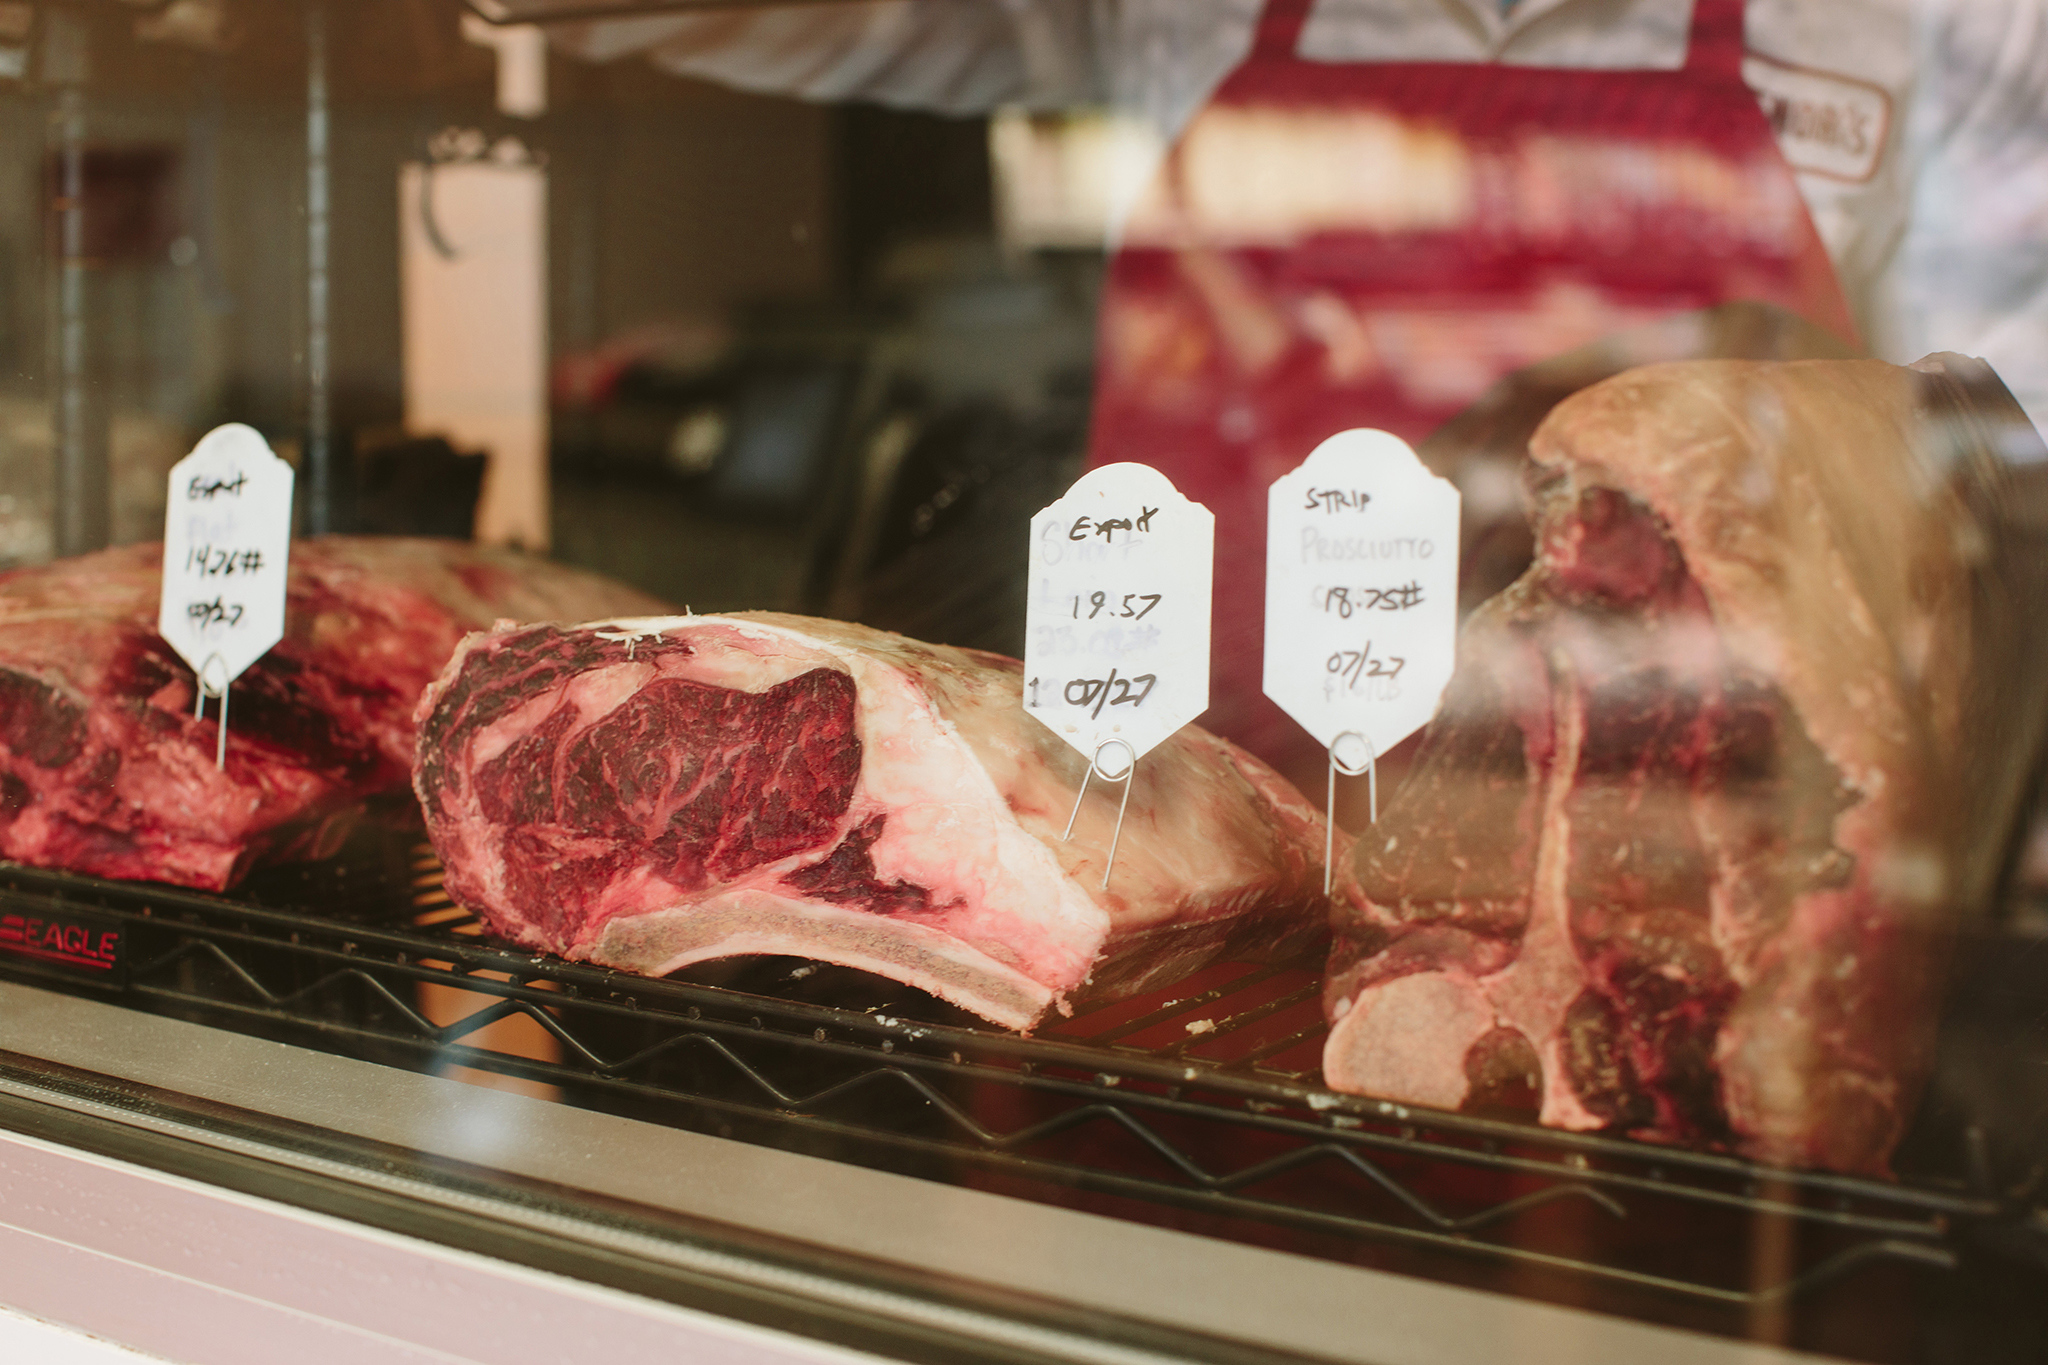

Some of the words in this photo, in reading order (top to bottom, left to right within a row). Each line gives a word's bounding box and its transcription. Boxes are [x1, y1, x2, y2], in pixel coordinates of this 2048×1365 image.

[1305, 487, 1372, 514] STRIP
[1072, 591, 1163, 621] 19.57
[1327, 640, 1406, 690] 07/27
[1063, 668, 1159, 721] 07/27
[25, 918, 119, 961] EAGLE
